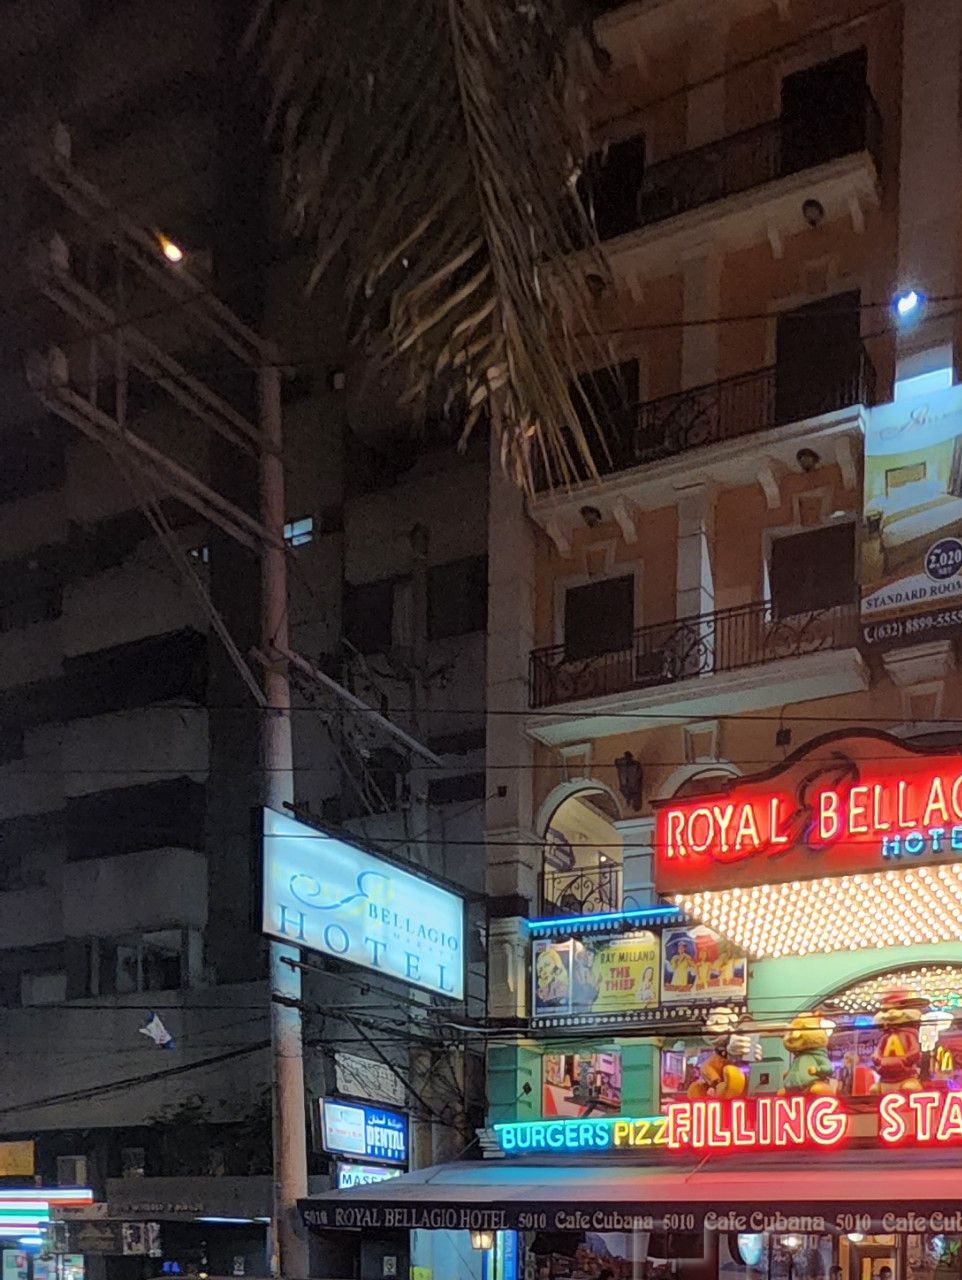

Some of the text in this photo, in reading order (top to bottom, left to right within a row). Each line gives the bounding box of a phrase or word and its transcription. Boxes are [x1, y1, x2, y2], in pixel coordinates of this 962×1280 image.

[865, 587, 927, 610] STANDARD
[873, 621, 903, 640] (632)
[666, 798, 789, 859] ROYAL
[368, 902, 459, 951] BELLAGIO
[277, 902, 454, 993] HOTEL
[600, 949, 656, 964] RAY MILLAND
[604, 977, 636, 992] THIEF
[609, 965, 631, 979] THE
[502, 1118, 673, 1149] BURGERS PIZZ
[668, 1096, 848, 1149] FILLING
[366, 1124, 405, 1151] DENTAL
[341, 1172, 385, 1187] MASS
[304, 1209, 328, 1226] 5010
[335, 1208, 382, 1228] ROYAL
[384, 1208, 458, 1229] BELLAGIO
[460, 1209, 510, 1230] HOTEL
[518, 1211, 547, 1229] 5010
[554, 1210, 591, 1230] Cafe
[593, 1210, 654, 1231] Cubana
[662, 1212, 695, 1231] 5010
[703, 1210, 748, 1232] Cafe
[750, 1210, 826, 1233] Cubana
[836, 1212, 872, 1231] 5010
[881, 1211, 927, 1233] Cafe
